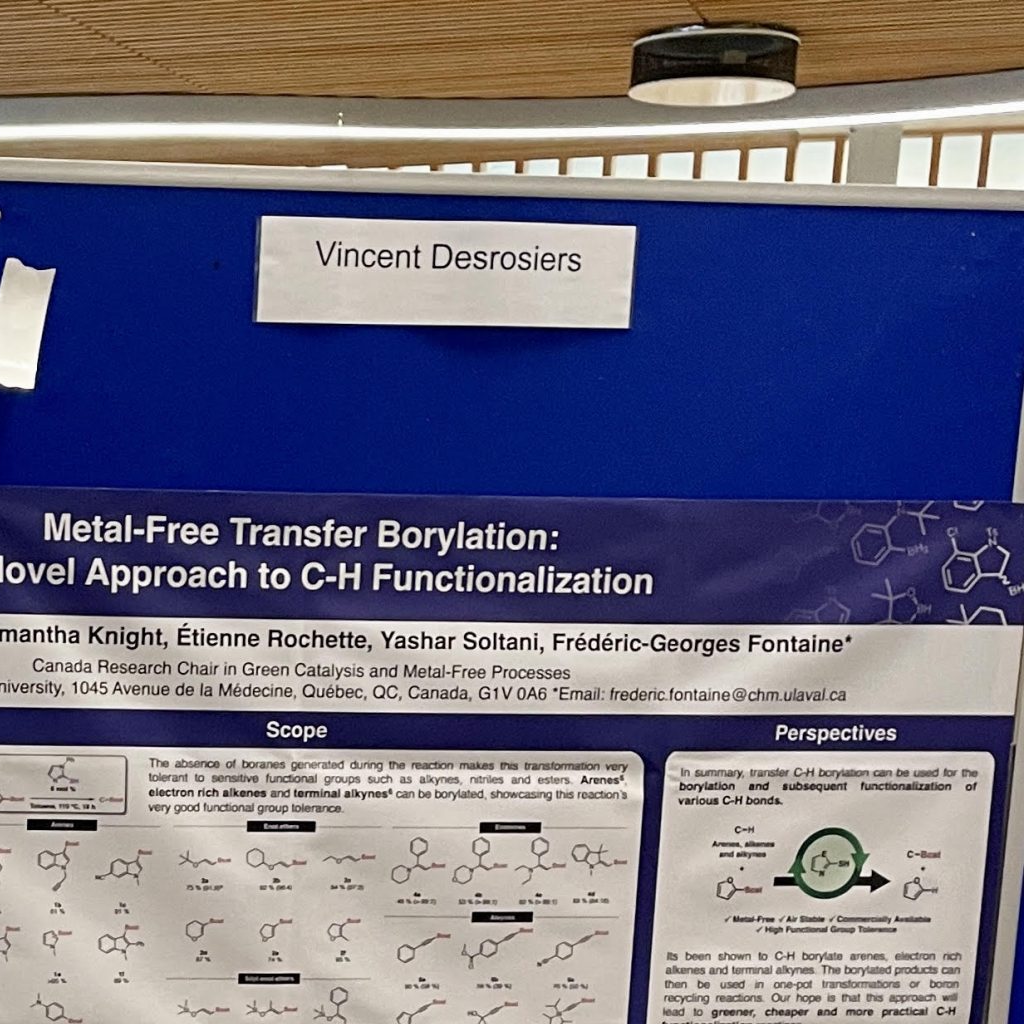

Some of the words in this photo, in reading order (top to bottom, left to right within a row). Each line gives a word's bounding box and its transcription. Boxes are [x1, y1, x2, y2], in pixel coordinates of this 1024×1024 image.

[315, 240, 422, 269] Vincent
[431, 243, 582, 272] Desrosiers
[43, 512, 220, 545] Metal-Free
[229, 517, 368, 547] Transfer
[377, 519, 559, 554] Borylation:
[84, 558, 248, 593] Approach
[257, 562, 292, 590] to
[300, 561, 362, 590] C-H
[372, 563, 654, 594] Functionalization
[88, 625, 169, 650] Knight,
[176, 622, 261, 647] Étienne
[267, 629, 373, 652] Rochette,
[380, 630, 457, 650] Yashar
[462, 631, 545, 654] Soltani,
[552, 632, 741, 657] Frédéric-Georges
[32, 657, 93, 674] Canada
[97, 658, 172, 675] Research
[177, 660, 220, 676] Chair
[223, 661, 237, 676] in
[242, 661, 290, 677] Green
[294, 662, 365, 681] Catalysis
[369, 664, 399, 678] and
[403, 663, 487, 679] Metal-Free
[491, 664, 571, 680] Processes
[72, 680, 109, 695] 1045
[112, 681, 171, 696] Avenue
[175, 682, 195, 697] de
[200, 682, 213, 697] la
[218, 682, 297, 699] Médecine,
[302, 683, 368, 701] Québec,
[372, 684, 403, 701] QC,
[408, 684, 473, 702] Canada,
[478, 685, 514, 701] G1V
[516, 686, 548, 701] 0A6
[609, 687, 847, 702] frederic.fontaine@chm.ulaval.ca
[265, 720, 328, 742] Scope
[775, 724, 898, 744] Perspectives
[679, 781, 736, 793] borylation
[748, 781, 770, 791] and
[782, 781, 848, 792] subsequent
[861, 781, 952, 791] functionalization
[965, 781, 978, 792] of
[147, 803, 172, 815] very
[173, 802, 201, 815] good
[203, 802, 256, 813] functional
[257, 804, 290, 815] group
[678, 796, 720, 805] various
[722, 795, 744, 805] C-H
